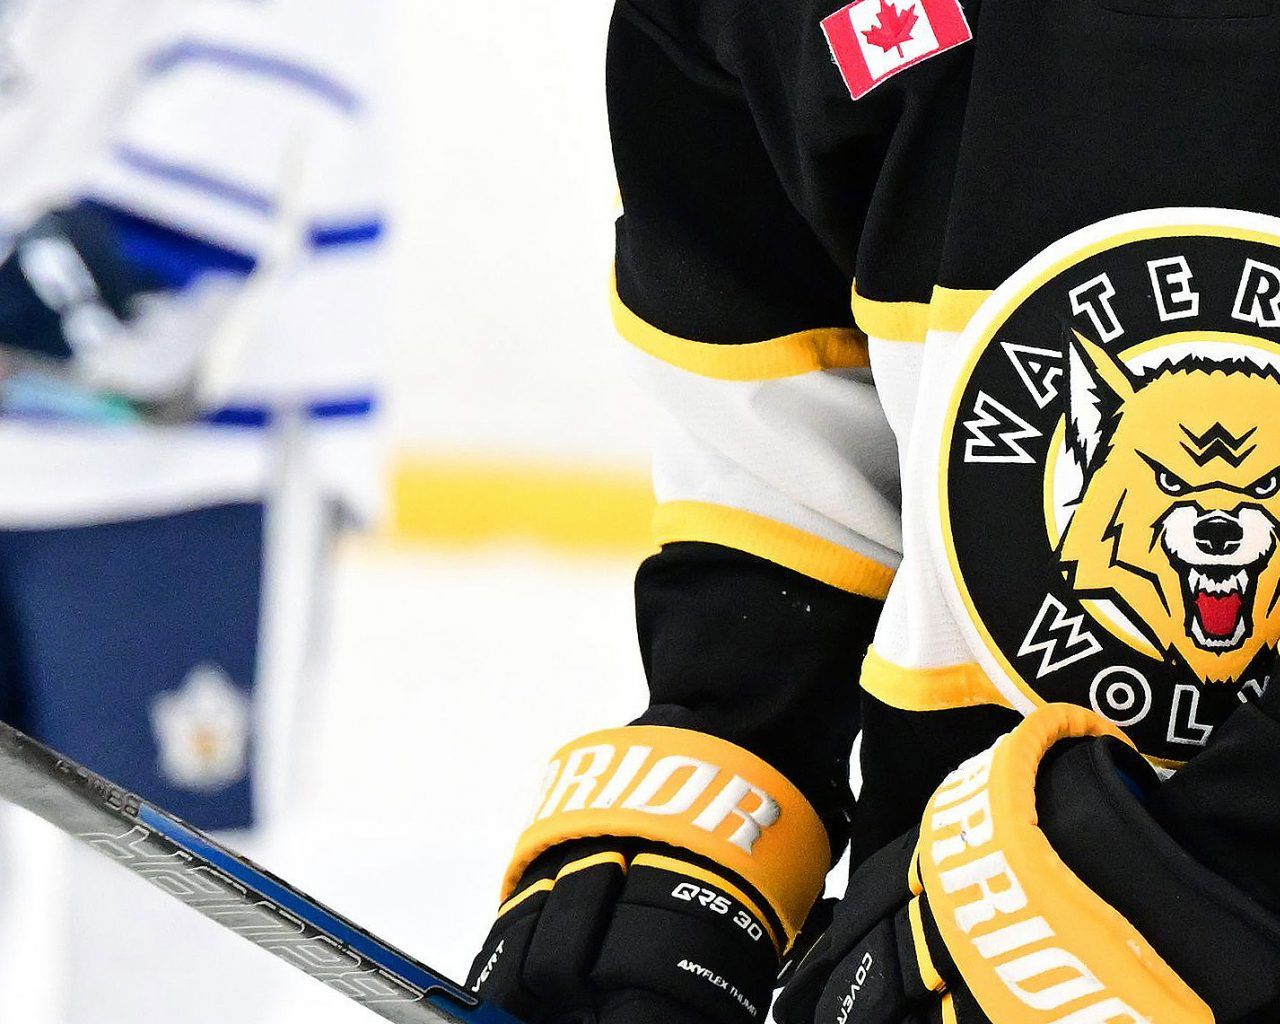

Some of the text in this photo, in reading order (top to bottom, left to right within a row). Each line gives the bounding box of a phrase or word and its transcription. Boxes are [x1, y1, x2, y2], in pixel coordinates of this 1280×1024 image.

[1016, 592, 1271, 747] WOL
[535, 743, 782, 856] RIOR
[732, 910, 763, 942] 30
[471, 938, 505, 993] VERT
[836, 951, 873, 1024] COVER
